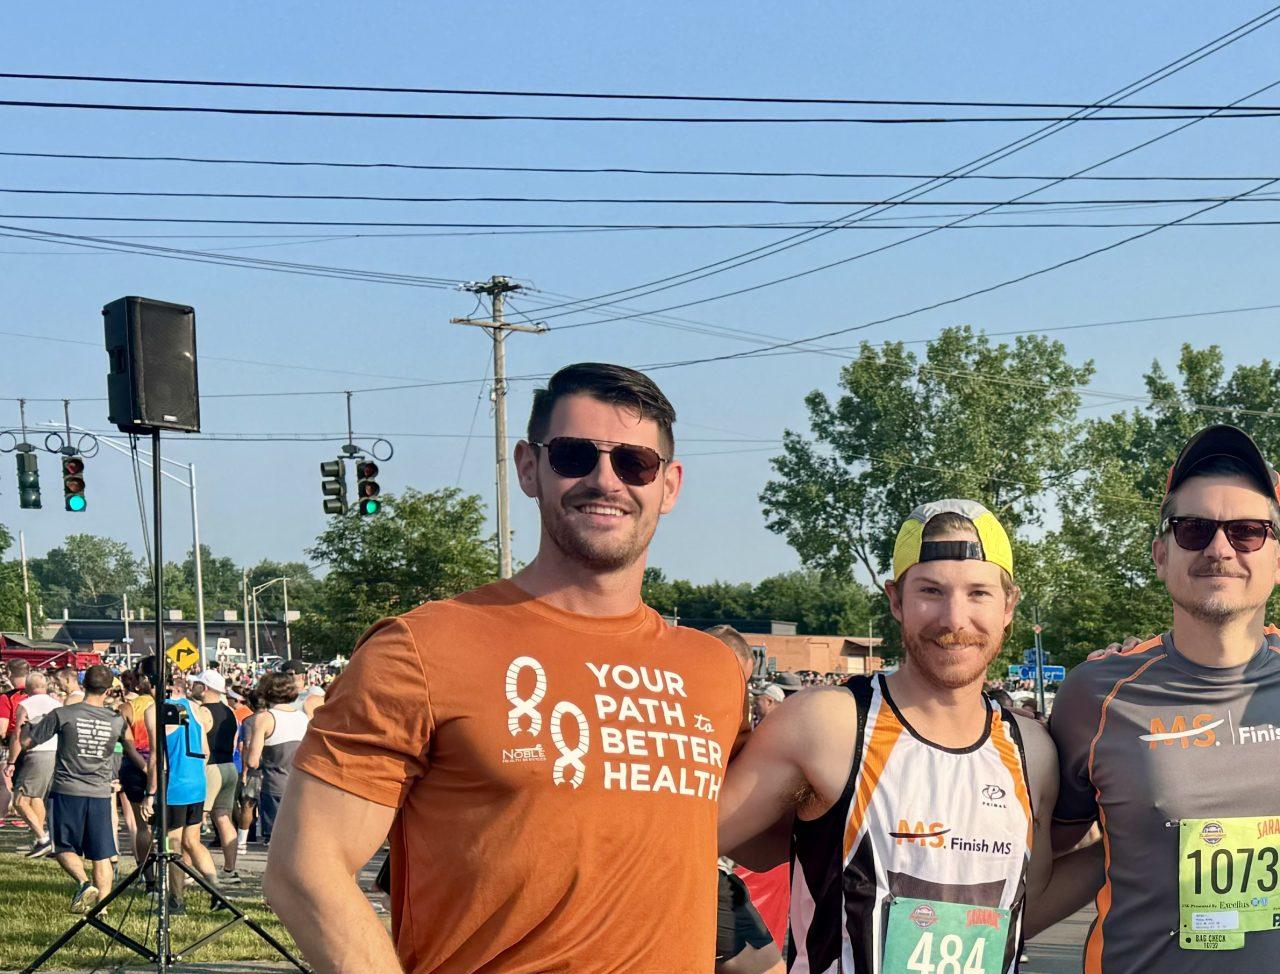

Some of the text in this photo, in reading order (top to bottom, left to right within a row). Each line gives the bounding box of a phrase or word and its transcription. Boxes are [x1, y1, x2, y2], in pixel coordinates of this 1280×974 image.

[585, 662, 687, 698] YOUR
[594, 694, 715, 733] PATH to
[600, 727, 723, 769] BETTER
[603, 762, 722, 802] HEALTH
[951, 838, 988, 853] Finish
[992, 841, 1012, 855] MS
